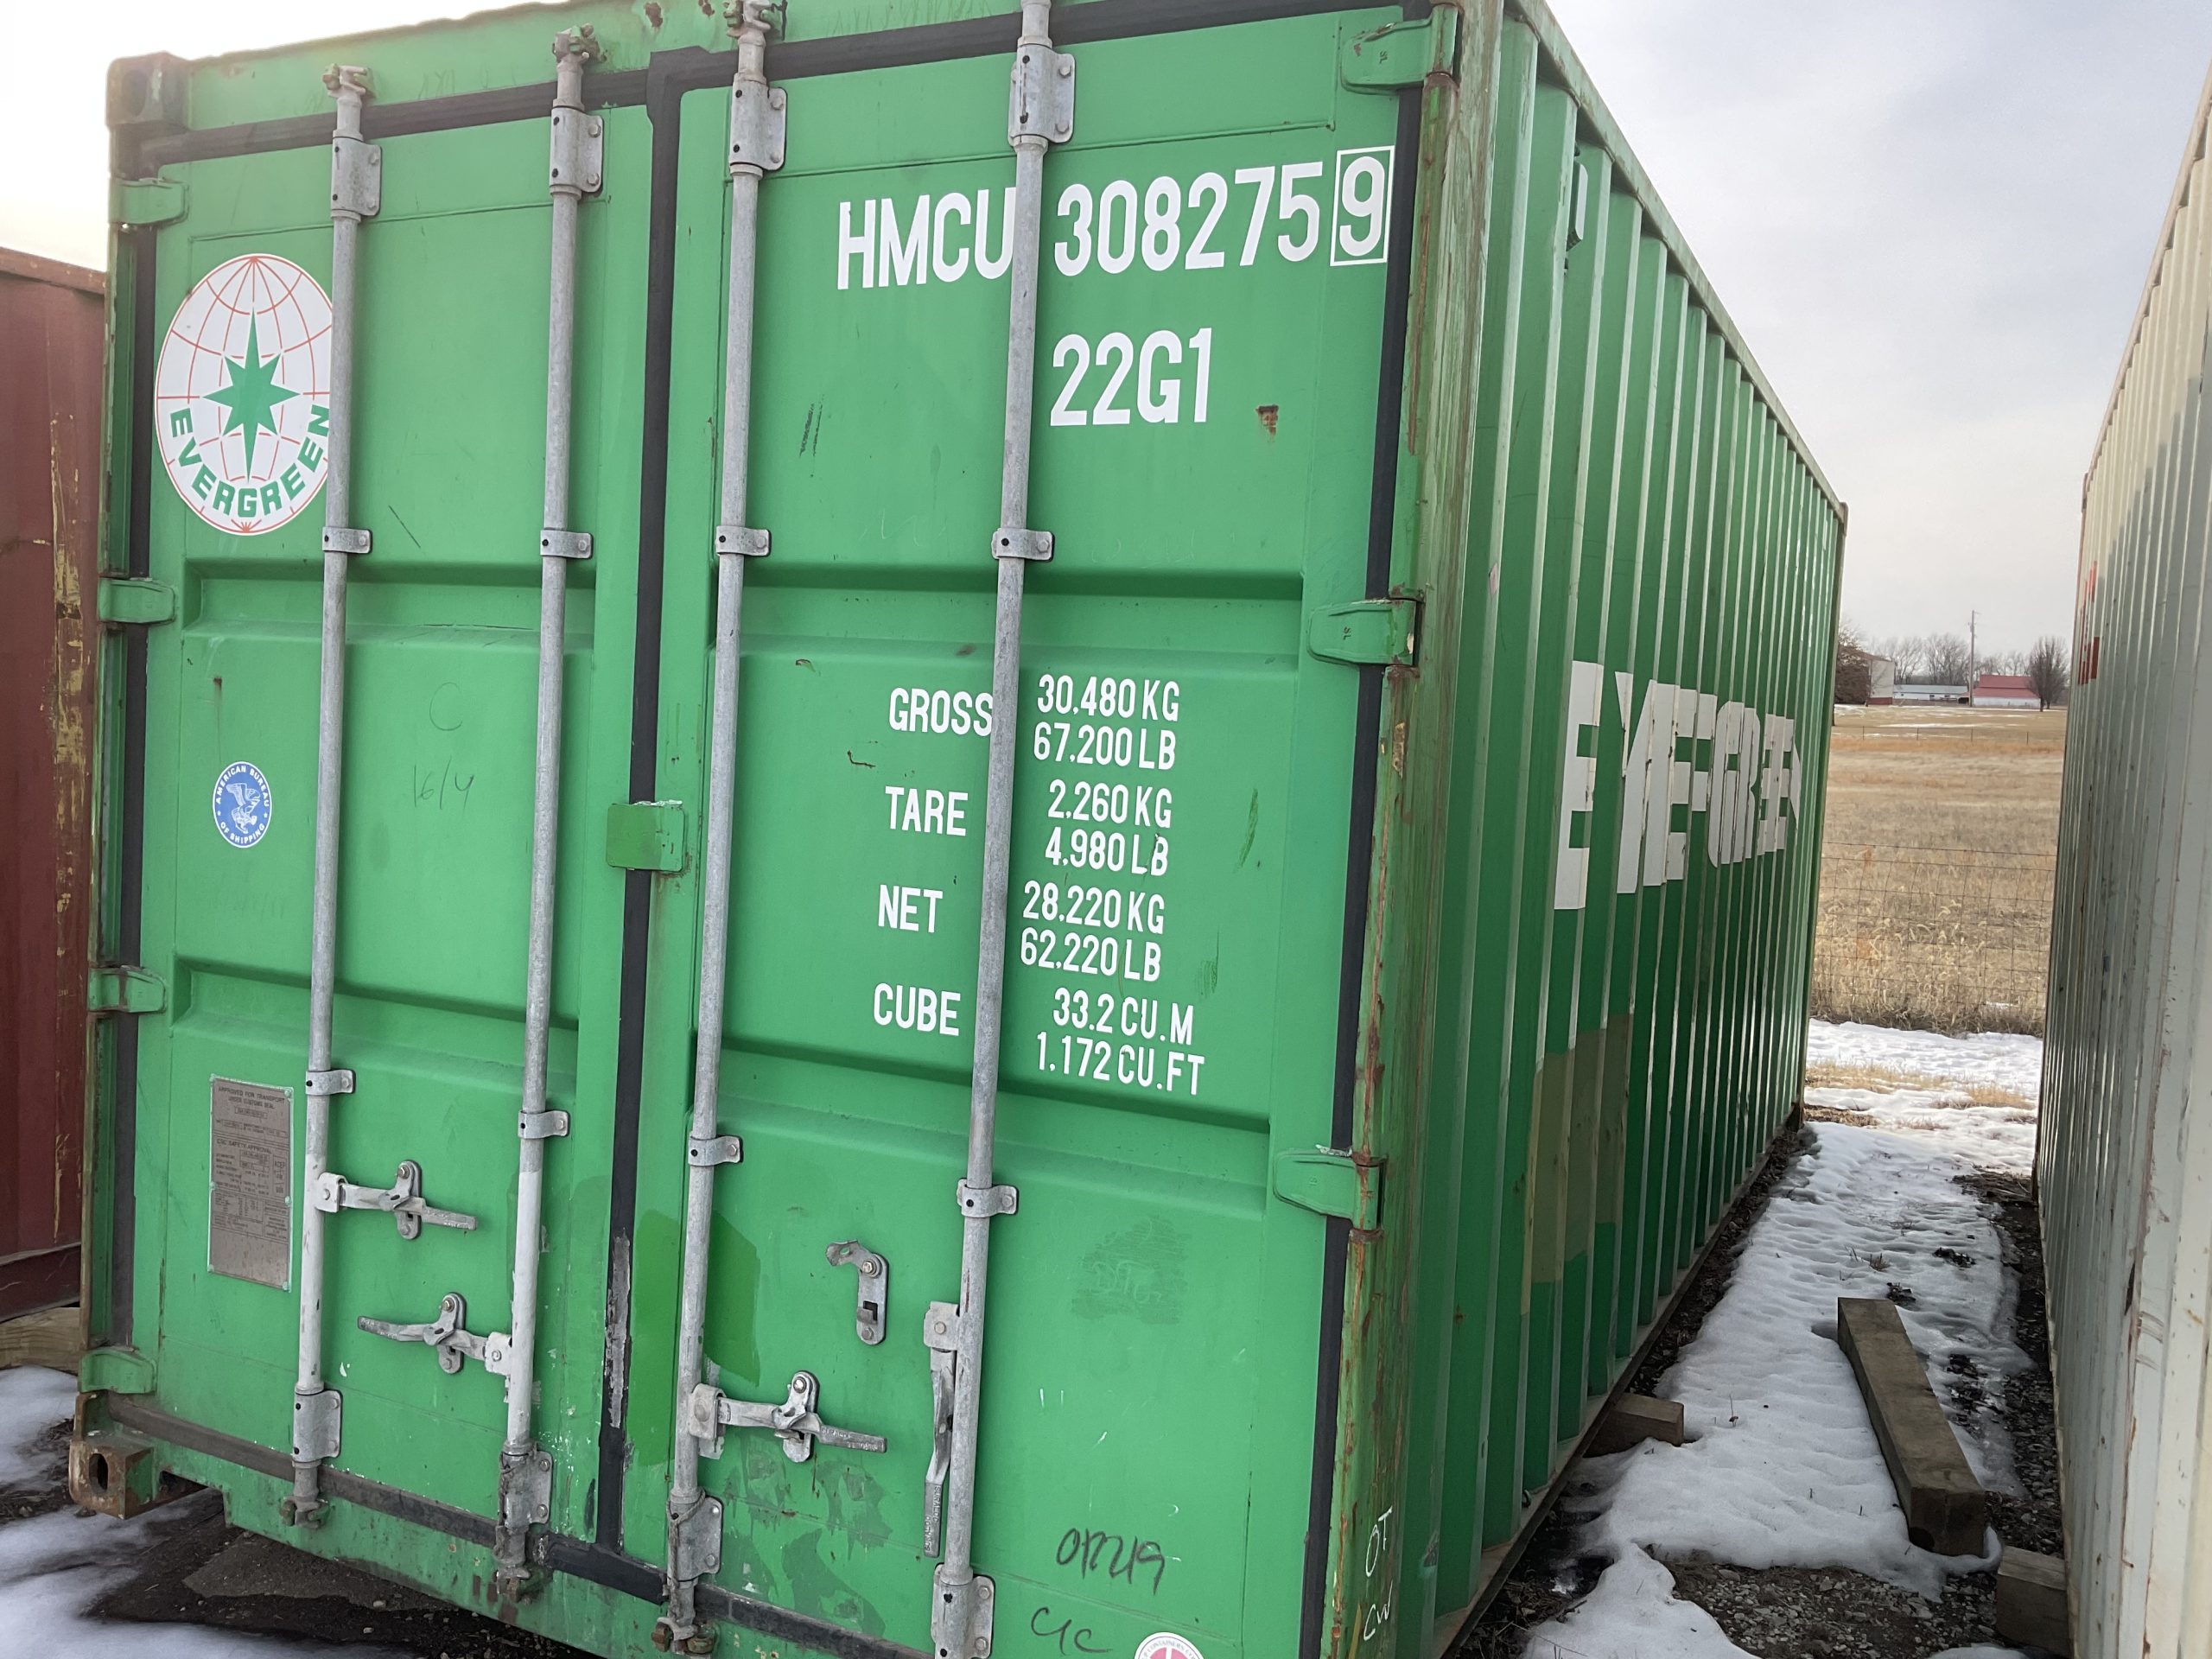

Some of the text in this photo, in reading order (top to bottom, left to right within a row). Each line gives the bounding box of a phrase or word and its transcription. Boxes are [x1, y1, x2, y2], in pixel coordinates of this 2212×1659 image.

[836, 186, 1016, 290] HMCU
[1050, 327, 1212, 427] 22G1
[169, 404, 330, 518] EVERGREEN
[889, 674, 1179, 737] GROSS 30,480 KG
[1033, 721, 1176, 770] 67,200 LB
[215, 765, 270, 807] AMERICAN BUREAU
[885, 779, 1173, 836] TARE 2,260 KG
[220, 821, 265, 844] OF SHIPPING
[1045, 826, 1169, 876] 4,980 LB
[878, 880, 1165, 935] NET 28,220 KG
[1020, 926, 1161, 982] 62,220 LB
[874, 982, 1194, 1046] CUBE 33.2 CU.M
[1117, 1044, 1205, 1096] CU.FT
[228, 1140, 247, 1149] SAFETY
[247, 1144, 272, 1155] APPROVAL
